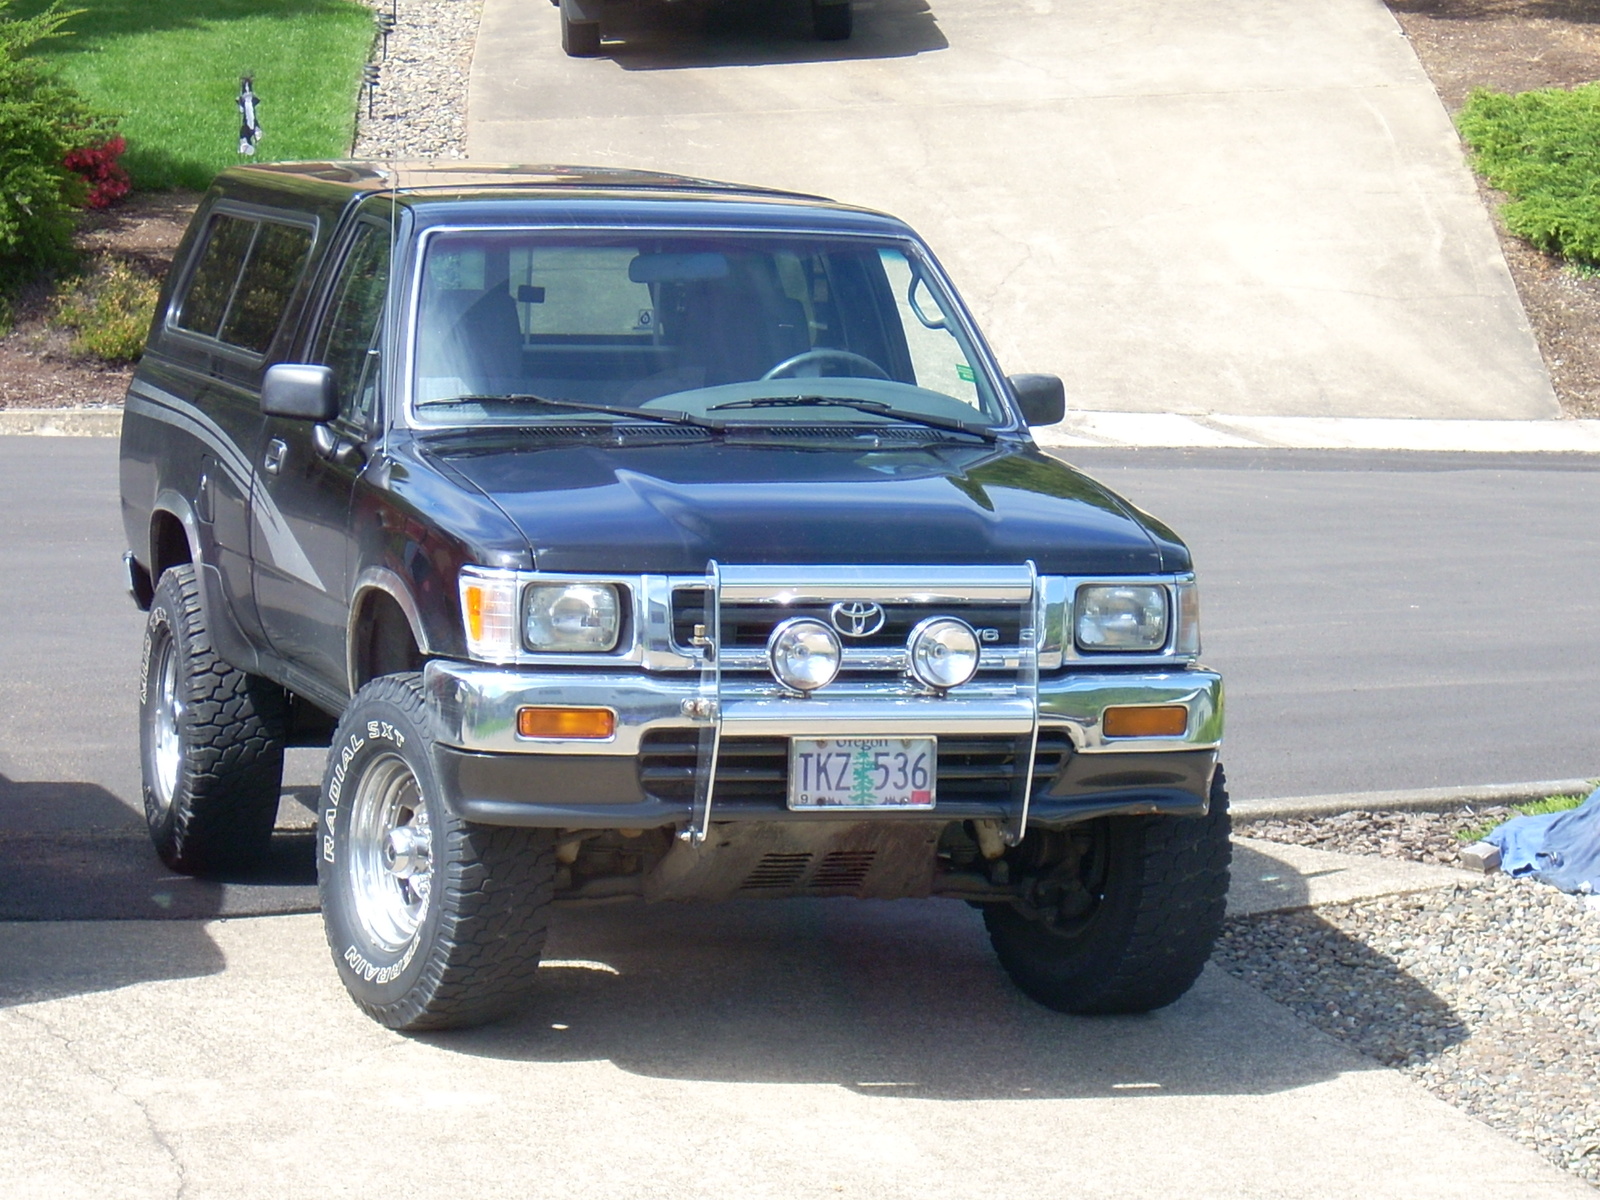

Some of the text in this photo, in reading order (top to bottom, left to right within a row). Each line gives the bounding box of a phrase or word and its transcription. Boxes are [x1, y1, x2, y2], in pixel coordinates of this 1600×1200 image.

[835, 739, 888, 751] Oregon
[799, 752, 928, 791] TKZ 536
[323, 720, 405, 863] RADIAL SXT
